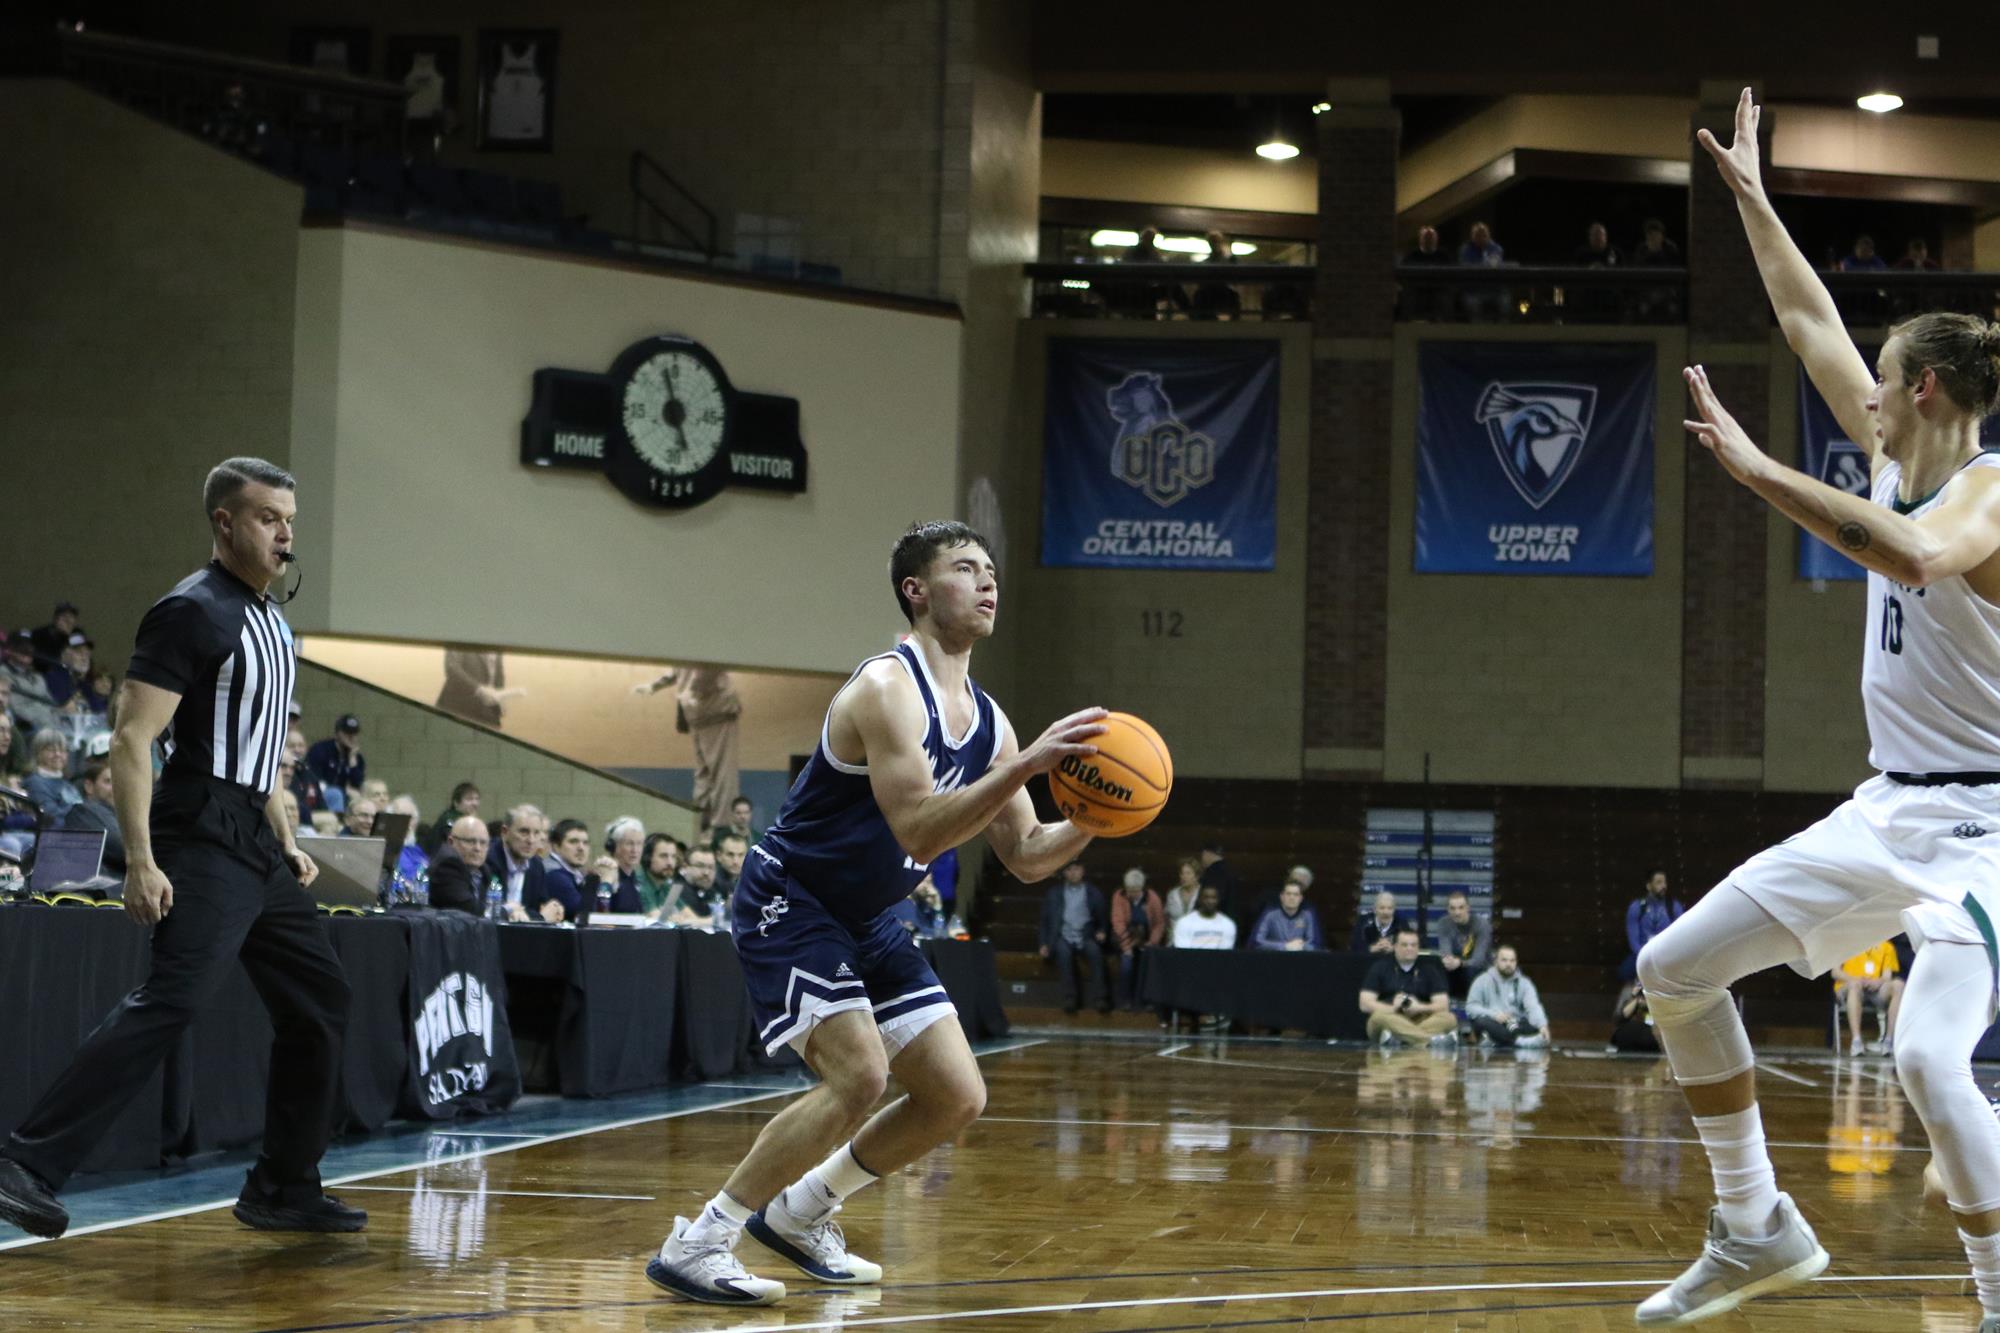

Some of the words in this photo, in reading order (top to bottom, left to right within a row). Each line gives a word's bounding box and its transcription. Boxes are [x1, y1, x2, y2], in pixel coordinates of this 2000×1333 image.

[554, 432, 606, 459] HOME
[730, 453, 795, 480] VISITOR
[649, 477, 657, 492] 1
[661, 481, 670, 497] 2
[672, 482, 682, 498] 3
[685, 480, 694, 495] 4
[1098, 520, 1220, 540] CENTRAL
[1488, 524, 1580, 545] UPPER
[1082, 537, 1234, 558] OKLAHOMA
[1494, 544, 1571, 562] IOWA
[1141, 610, 1184, 638] 112
[1060, 754, 1134, 803] Wilson
